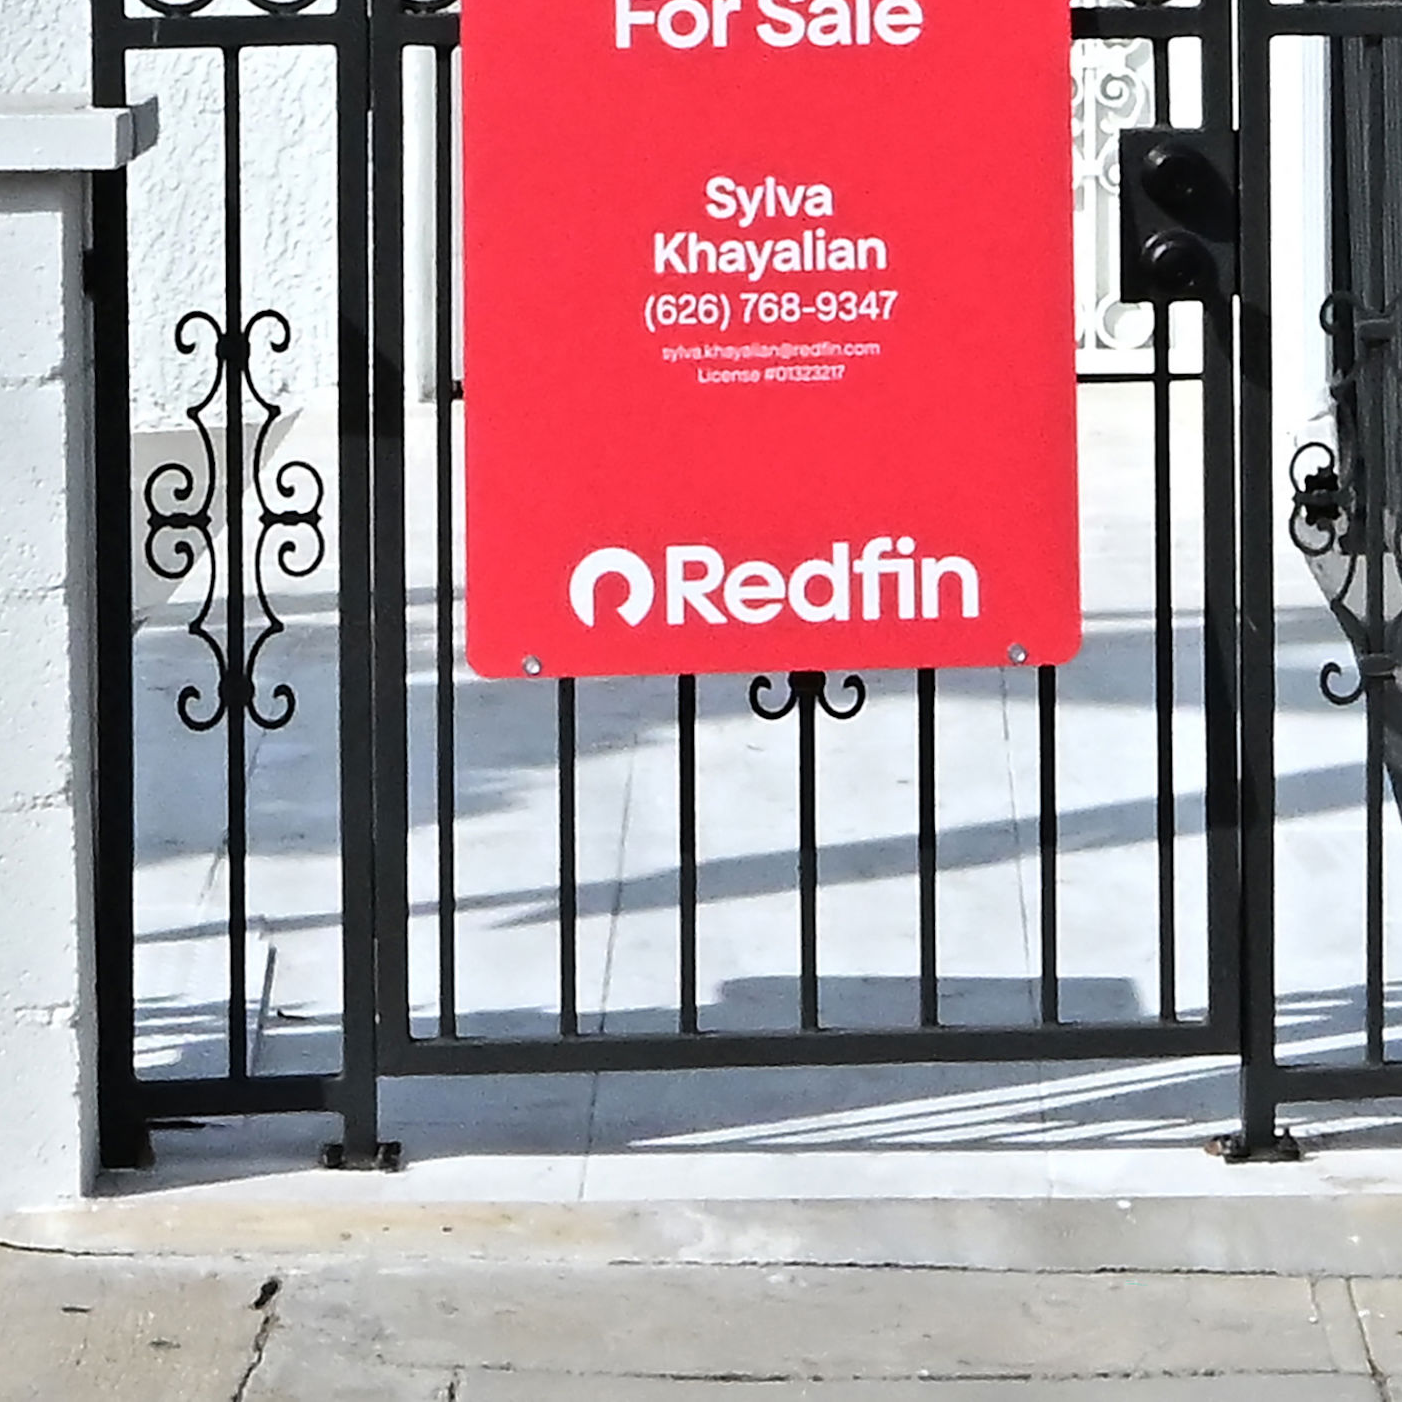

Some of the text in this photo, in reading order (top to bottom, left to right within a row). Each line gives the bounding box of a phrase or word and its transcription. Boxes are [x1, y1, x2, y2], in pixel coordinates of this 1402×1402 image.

[705, 175, 834, 228] Sylva
[654, 228, 888, 282] Khayalian
[644, 290, 899, 333] (626) 768-9347
[662, 342, 881, 362] sylva.khayalian@redfin.com
[698, 368, 761, 384] License
[665, 536, 980, 626] Redfin
